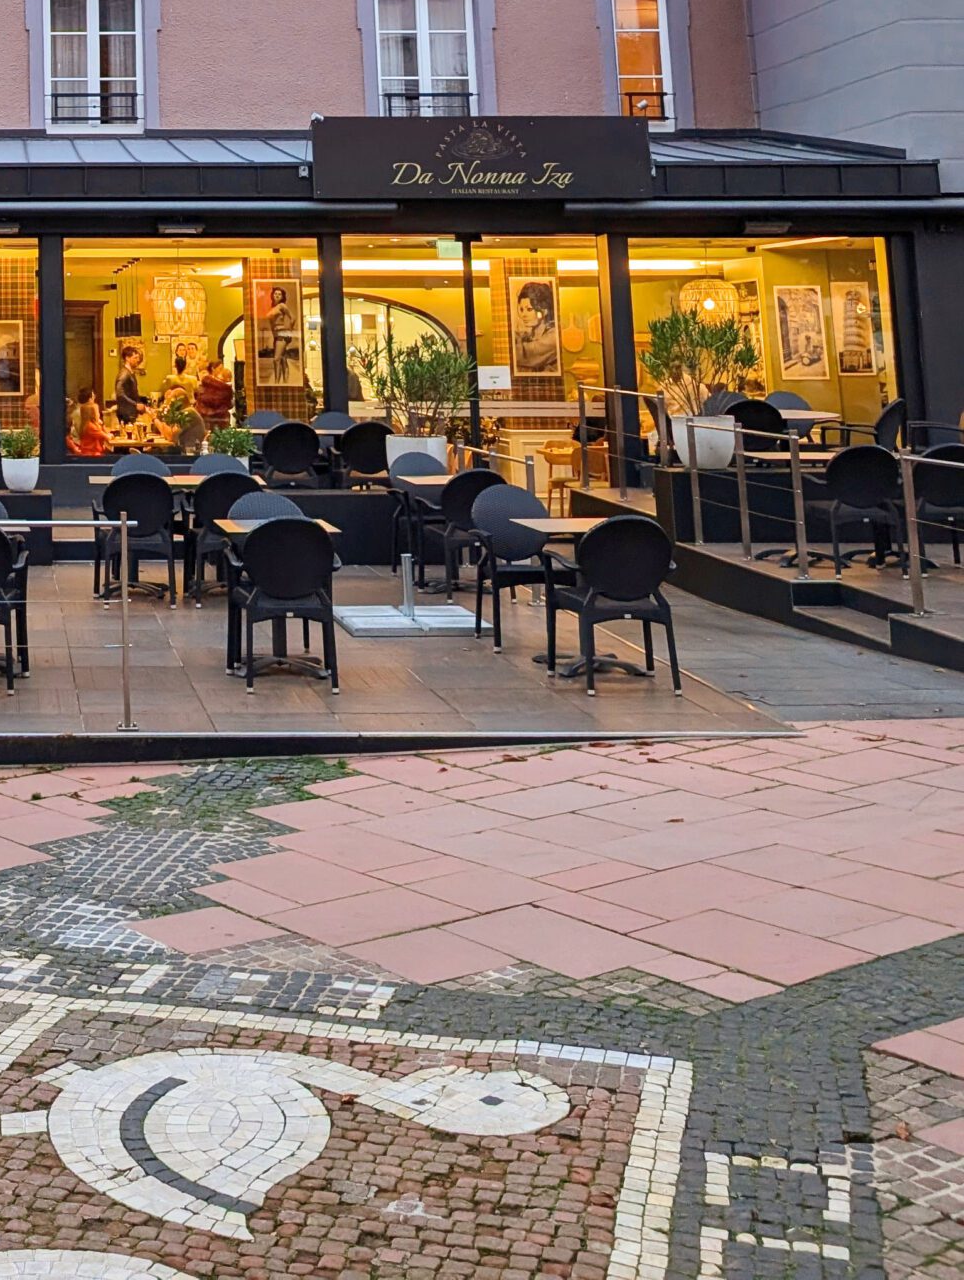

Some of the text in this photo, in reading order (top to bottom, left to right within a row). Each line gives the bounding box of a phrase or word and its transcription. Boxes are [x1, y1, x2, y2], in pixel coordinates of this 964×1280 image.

[435, 120, 528, 158] PASTA LA VISTA
[391, 160, 574, 190] Da Nonna Iza
[450, 187, 520, 195] ITALIAN RESTAURANT
